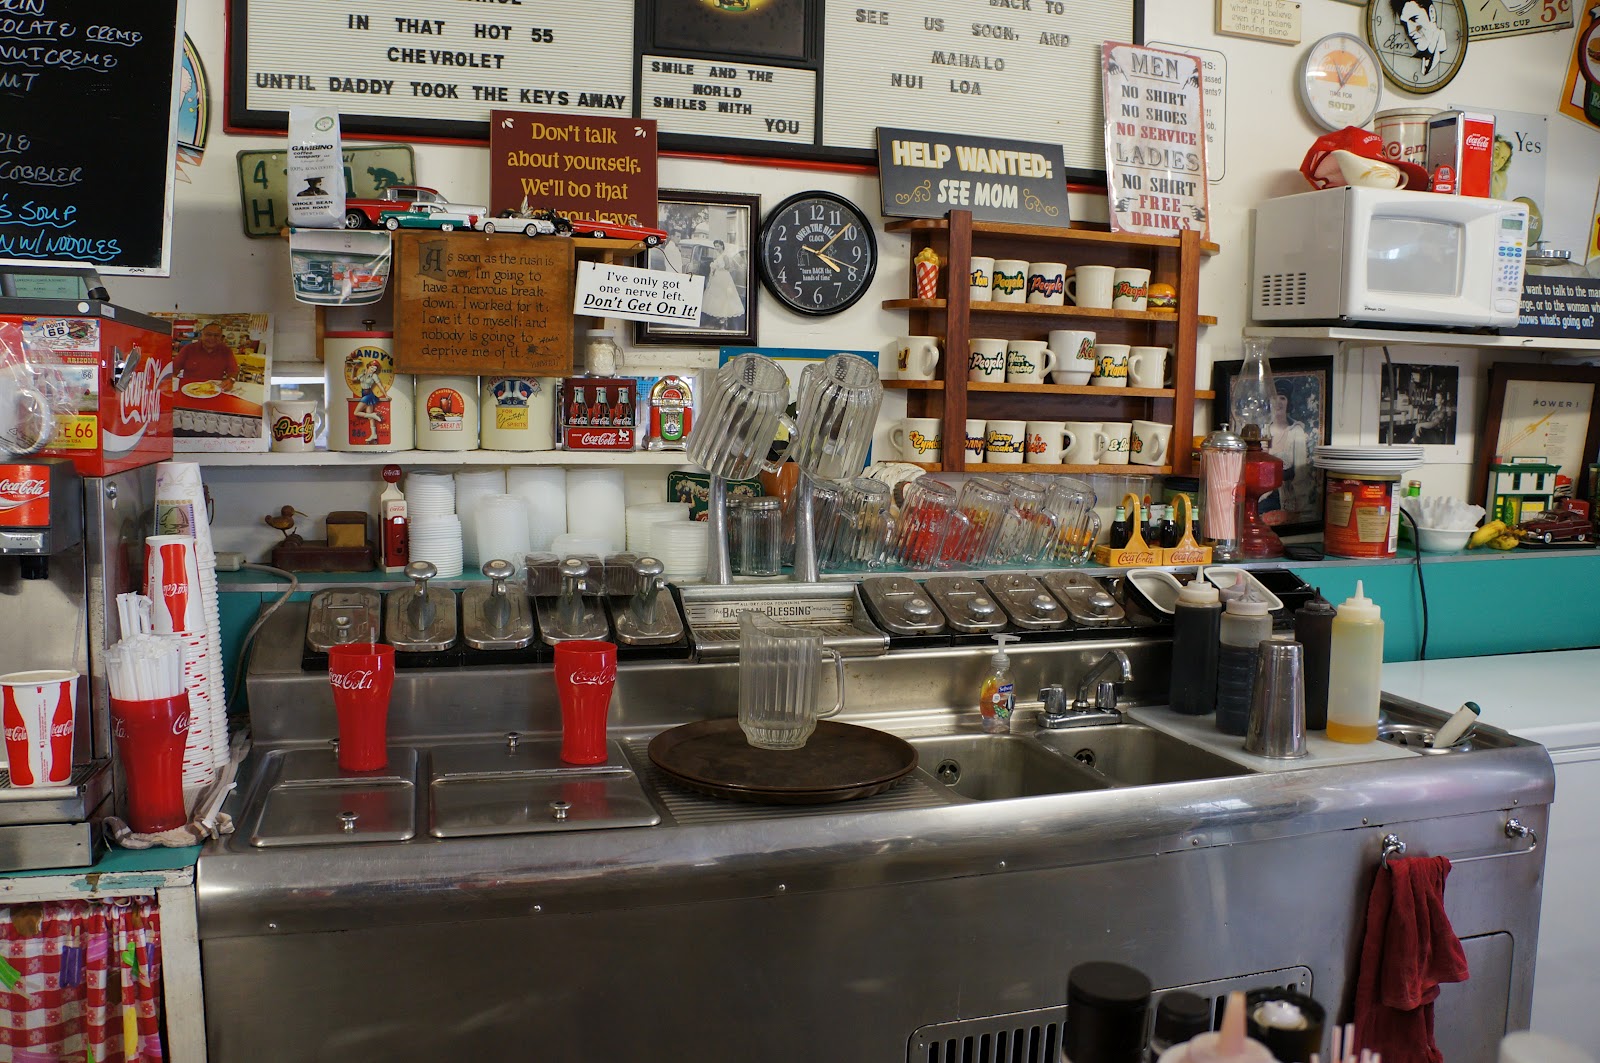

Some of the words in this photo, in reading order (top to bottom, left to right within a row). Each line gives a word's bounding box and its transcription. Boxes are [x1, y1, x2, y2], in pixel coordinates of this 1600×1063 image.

[1045, 0, 1065, 15] TO
[347, 14, 370, 31] IN
[395, 17, 445, 36] THAT
[474, 23, 512, 42] HOT
[531, 27, 554, 44] 55
[855, 8, 889, 26] SEE
[924, 16, 945, 32] US
[972, 22, 1020, 42] SOON,
[1039, 31, 1071, 48] AND
[1376, 15, 1382, 27] 9
[1513, 18, 1531, 28] CUP
[86, 25, 144, 43] CREME
[45, 48, 118, 68] CREME
[387, 46, 505, 70] CHEVROLET
[931, 50, 1006, 72] MAHALO
[1130, 52, 1180, 81] MEN
[651, 60, 695, 76] SMILE
[709, 66, 737, 80] AND
[747, 69, 774, 83] THE
[1412, 71, 1419, 83] 6
[255, 72, 316, 92] UNTIL
[328, 76, 395, 97] DADDY
[410, 80, 460, 100] TOOK
[472, 85, 509, 103] THE
[520, 88, 570, 108] KEYS
[576, 92, 627, 111] AWAY
[692, 83, 743, 99] WORLD
[890, 72, 924, 91] NUI
[950, 79, 983, 97] LOA
[1121, 84, 1140, 100] NO
[1146, 88, 1188, 108] SHIRT
[652, 96, 708, 112] SMILES
[718, 101, 753, 116] WITH
[1121, 103, 1140, 119] NO
[1146, 107, 1188, 126] SHOES
[1327, 100, 1356, 112] SOUP
[584, 125, 618, 144] talk
[764, 118, 801, 136] YOU
[1115, 121, 1137, 137] NO
[1140, 125, 1198, 147] SERVICE
[291, 144, 334, 152] GAMBINO
[1514, 131, 1542, 154] Yes
[507, 150, 560, 168] about
[562, 155, 642, 175] yourself.
[891, 139, 952, 170] HELP
[955, 145, 1054, 180] WANTED:
[1115, 142, 1201, 173] LADIES
[252, 160, 269, 190] 4
[521, 178, 565, 198] We'll
[568, 180, 592, 198] do
[595, 182, 629, 202] that
[937, 179, 971, 206] SEE
[974, 181, 1019, 210] MOM
[1121, 173, 1142, 190] NO
[1150, 177, 1197, 198] SHIRT
[19, 201, 77, 221] SOUP
[252, 198, 276, 229] H
[810, 204, 825, 221] 12
[1138, 194, 1182, 214] FREE
[793, 209, 801, 226] 1
[829, 210, 842, 226] 11
[1131, 211, 1191, 232] DRINKS
[777, 224, 788, 242] 2
[843, 225, 858, 241] 10
[795, 225, 812, 242] OVER
[810, 223, 824, 233] THE
[808, 234, 825, 243] CLOCK
[46, 234, 122, 255] NOODLES
[457, 251, 482, 264] soon
[484, 255, 498, 265] as
[499, 253, 517, 265] the
[519, 254, 543, 267] rush
[545, 255, 555, 267] is
[773, 246, 783, 264] 3
[851, 245, 862, 264] 9
[446, 267, 472, 281] over,
[475, 266, 491, 280] I'm
[492, 270, 525, 286] going
[528, 269, 543, 282] to
[606, 270, 629, 283] I've
[632, 276, 659, 289] only
[662, 279, 681, 290] got
[776, 265, 788, 284] 4
[847, 266, 857, 282] 8
[422, 279, 448, 294] have
[451, 283, 459, 294] a
[462, 284, 508, 296] nervous
[511, 282, 548, 298] break-
[599, 284, 621, 294] one
[625, 287, 659, 299] nerve
[661, 290, 686, 302] left.
[793, 281, 803, 299] 5
[833, 281, 842, 299] 7
[813, 286, 823, 305] 6
[1525, 284, 1543, 296] want
[1543, 285, 1552, 296] to
[1552, 284, 1567, 296] talk
[1566, 286, 1575, 298] to
[1574, 285, 1587, 298] the
[422, 296, 458, 310] down.
[462, 296, 468, 310] I
[469, 298, 513, 313] worked
[516, 299, 532, 313] for
[583, 293, 623, 309] Don't
[627, 298, 653, 312] Get
[656, 301, 677, 315] On
[681, 304, 699, 317] It!
[1536, 300, 1544, 310] or
[1545, 300, 1553, 311] to
[1552, 299, 1565, 312] the
[1566, 302, 1591, 313] woman
[46, 321, 66, 330] ROUTE
[428, 313, 451, 325] owe
[453, 314, 463, 326] it
[467, 313, 481, 326] to
[525, 316, 548, 329] and
[1539, 314, 1561, 326] what's
[1562, 315, 1582, 330] going
[1581, 315, 1595, 327] on?
[48, 328, 66, 338] 66
[421, 330, 466, 344] nobody
[469, 329, 478, 342] is
[480, 332, 516, 348] going
[521, 330, 534, 344] to
[66, 356, 99, 365] ARIZONA
[421, 345, 468, 360] deprive
[471, 347, 490, 357] me
[494, 346, 506, 361] of
[510, 346, 525, 359] it.
[75, 423, 94, 438] 66
[274, 415, 315, 444] Andy
[581, 431, 618, 446] Coca-Cola
